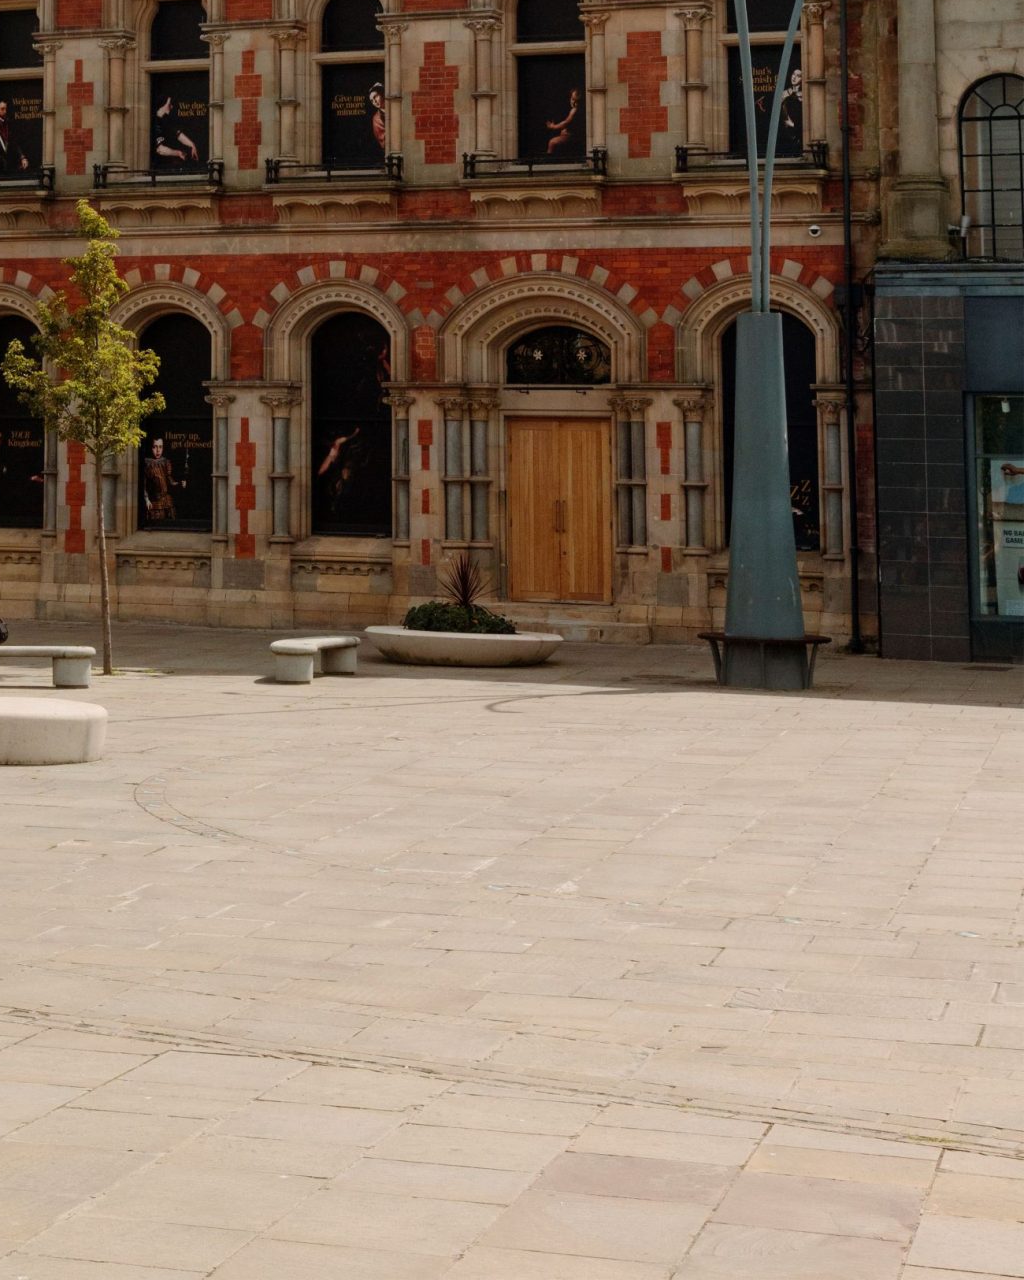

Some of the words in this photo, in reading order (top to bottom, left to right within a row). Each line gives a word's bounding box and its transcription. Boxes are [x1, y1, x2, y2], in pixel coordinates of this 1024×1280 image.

[12, 97, 43, 105] Welcome
[334, 94, 351, 103] Give
[353, 95, 366, 103] me
[20, 105, 28, 113] to
[28, 105, 39, 114] my
[165, 431, 187, 442] Hurry
